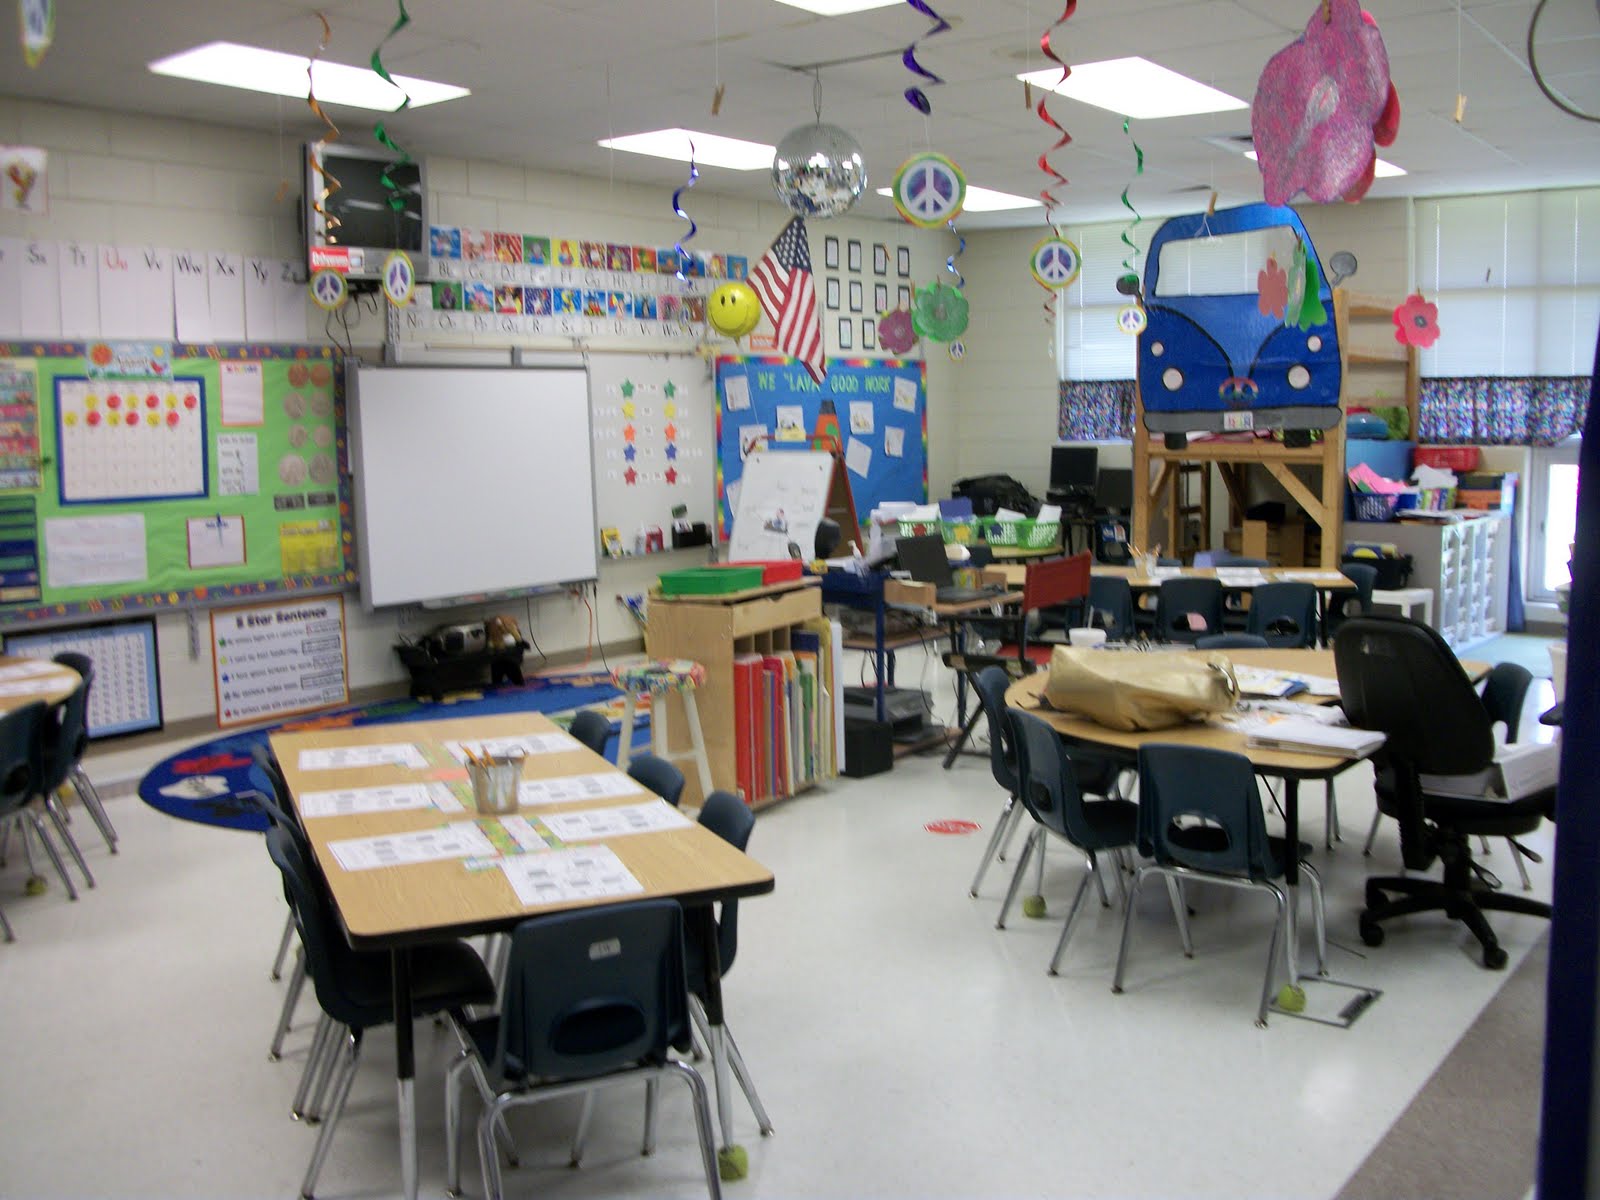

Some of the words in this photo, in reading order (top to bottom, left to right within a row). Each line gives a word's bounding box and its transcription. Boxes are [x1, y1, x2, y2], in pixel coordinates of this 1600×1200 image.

[758, 371, 776, 392] WE
[830, 374, 859, 394] GOOD
[863, 374, 891, 393] WORK
[247, 613, 273, 628] Star
[276, 607, 327, 623] Sentence
